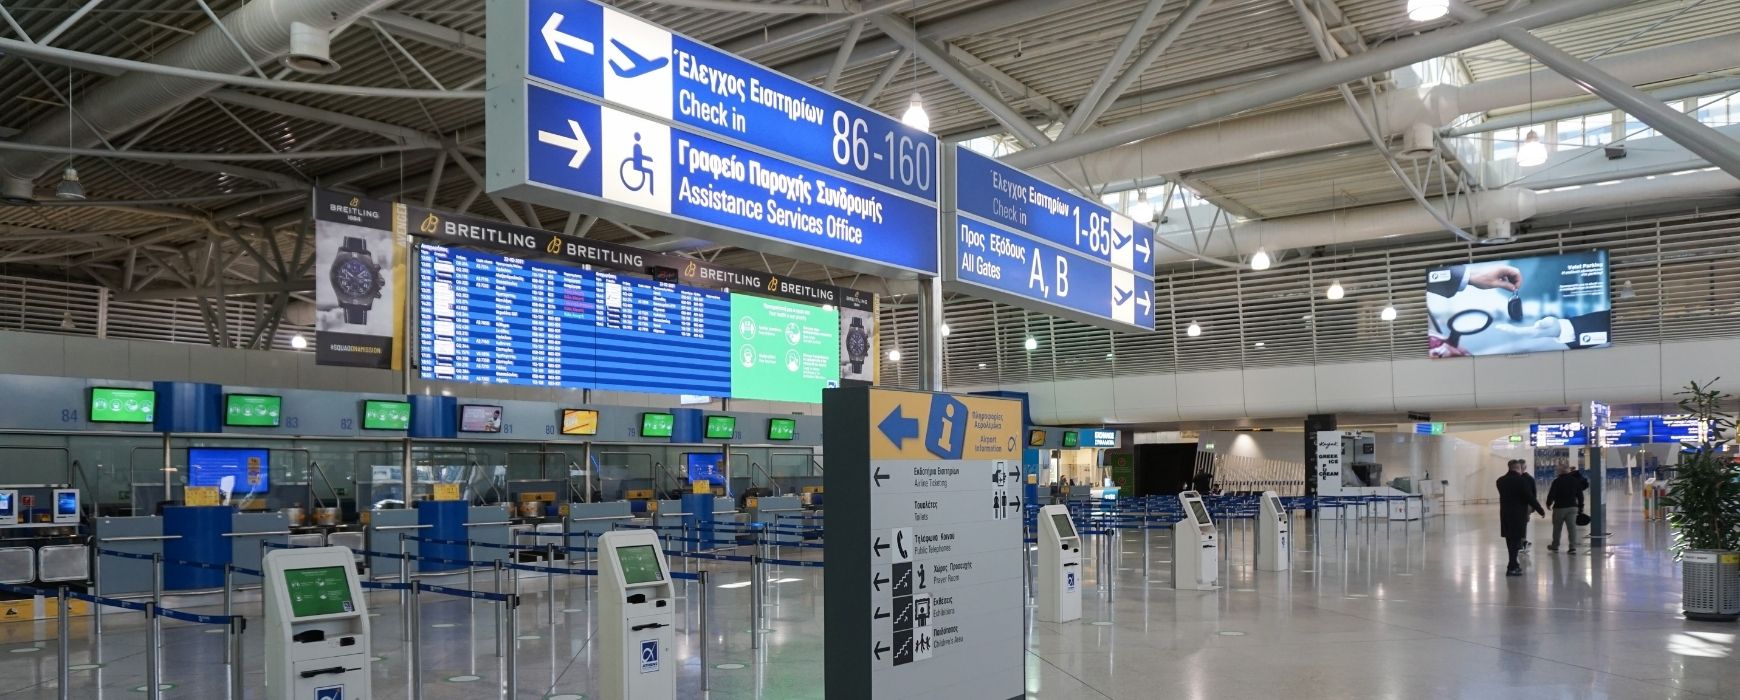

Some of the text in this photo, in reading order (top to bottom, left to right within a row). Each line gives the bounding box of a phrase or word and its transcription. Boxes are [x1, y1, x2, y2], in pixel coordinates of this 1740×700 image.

[674, 48, 824, 126] Έλεγχος Εισιτηρίων
[679, 88, 746, 133] Check in
[832, 110, 930, 191] 86-160
[678, 138, 883, 224] Γραφείο Παροχής Συνδρομής
[329, 203, 380, 218] BREITLING
[679, 176, 862, 244] Assistance Services Office
[992, 197, 1027, 226] Check in
[1029, 186, 1069, 217] Εισιτηρίων
[444, 221, 537, 249] BREITLING
[1073, 206, 1110, 255] 1-85
[566, 242, 643, 267] BREITLING
[961, 224, 1026, 264] Προς Εξόδους
[962, 252, 1001, 280] All Gates
[700, 267, 761, 288] BREITLING
[781, 281, 834, 301] BREITLING
[62, 408, 78, 422] 84
[286, 417, 298, 428] 83
[340, 418, 353, 430] 82
[503, 423, 513, 434] 81
[545, 424, 555, 435] 80
[974, 444, 1002, 452] Information
[980, 435, 997, 444] Airport
[914, 478, 948, 489] Airline Ticketing
[914, 512, 929, 521] Toilets
[928, 545, 951, 553] Telephones
